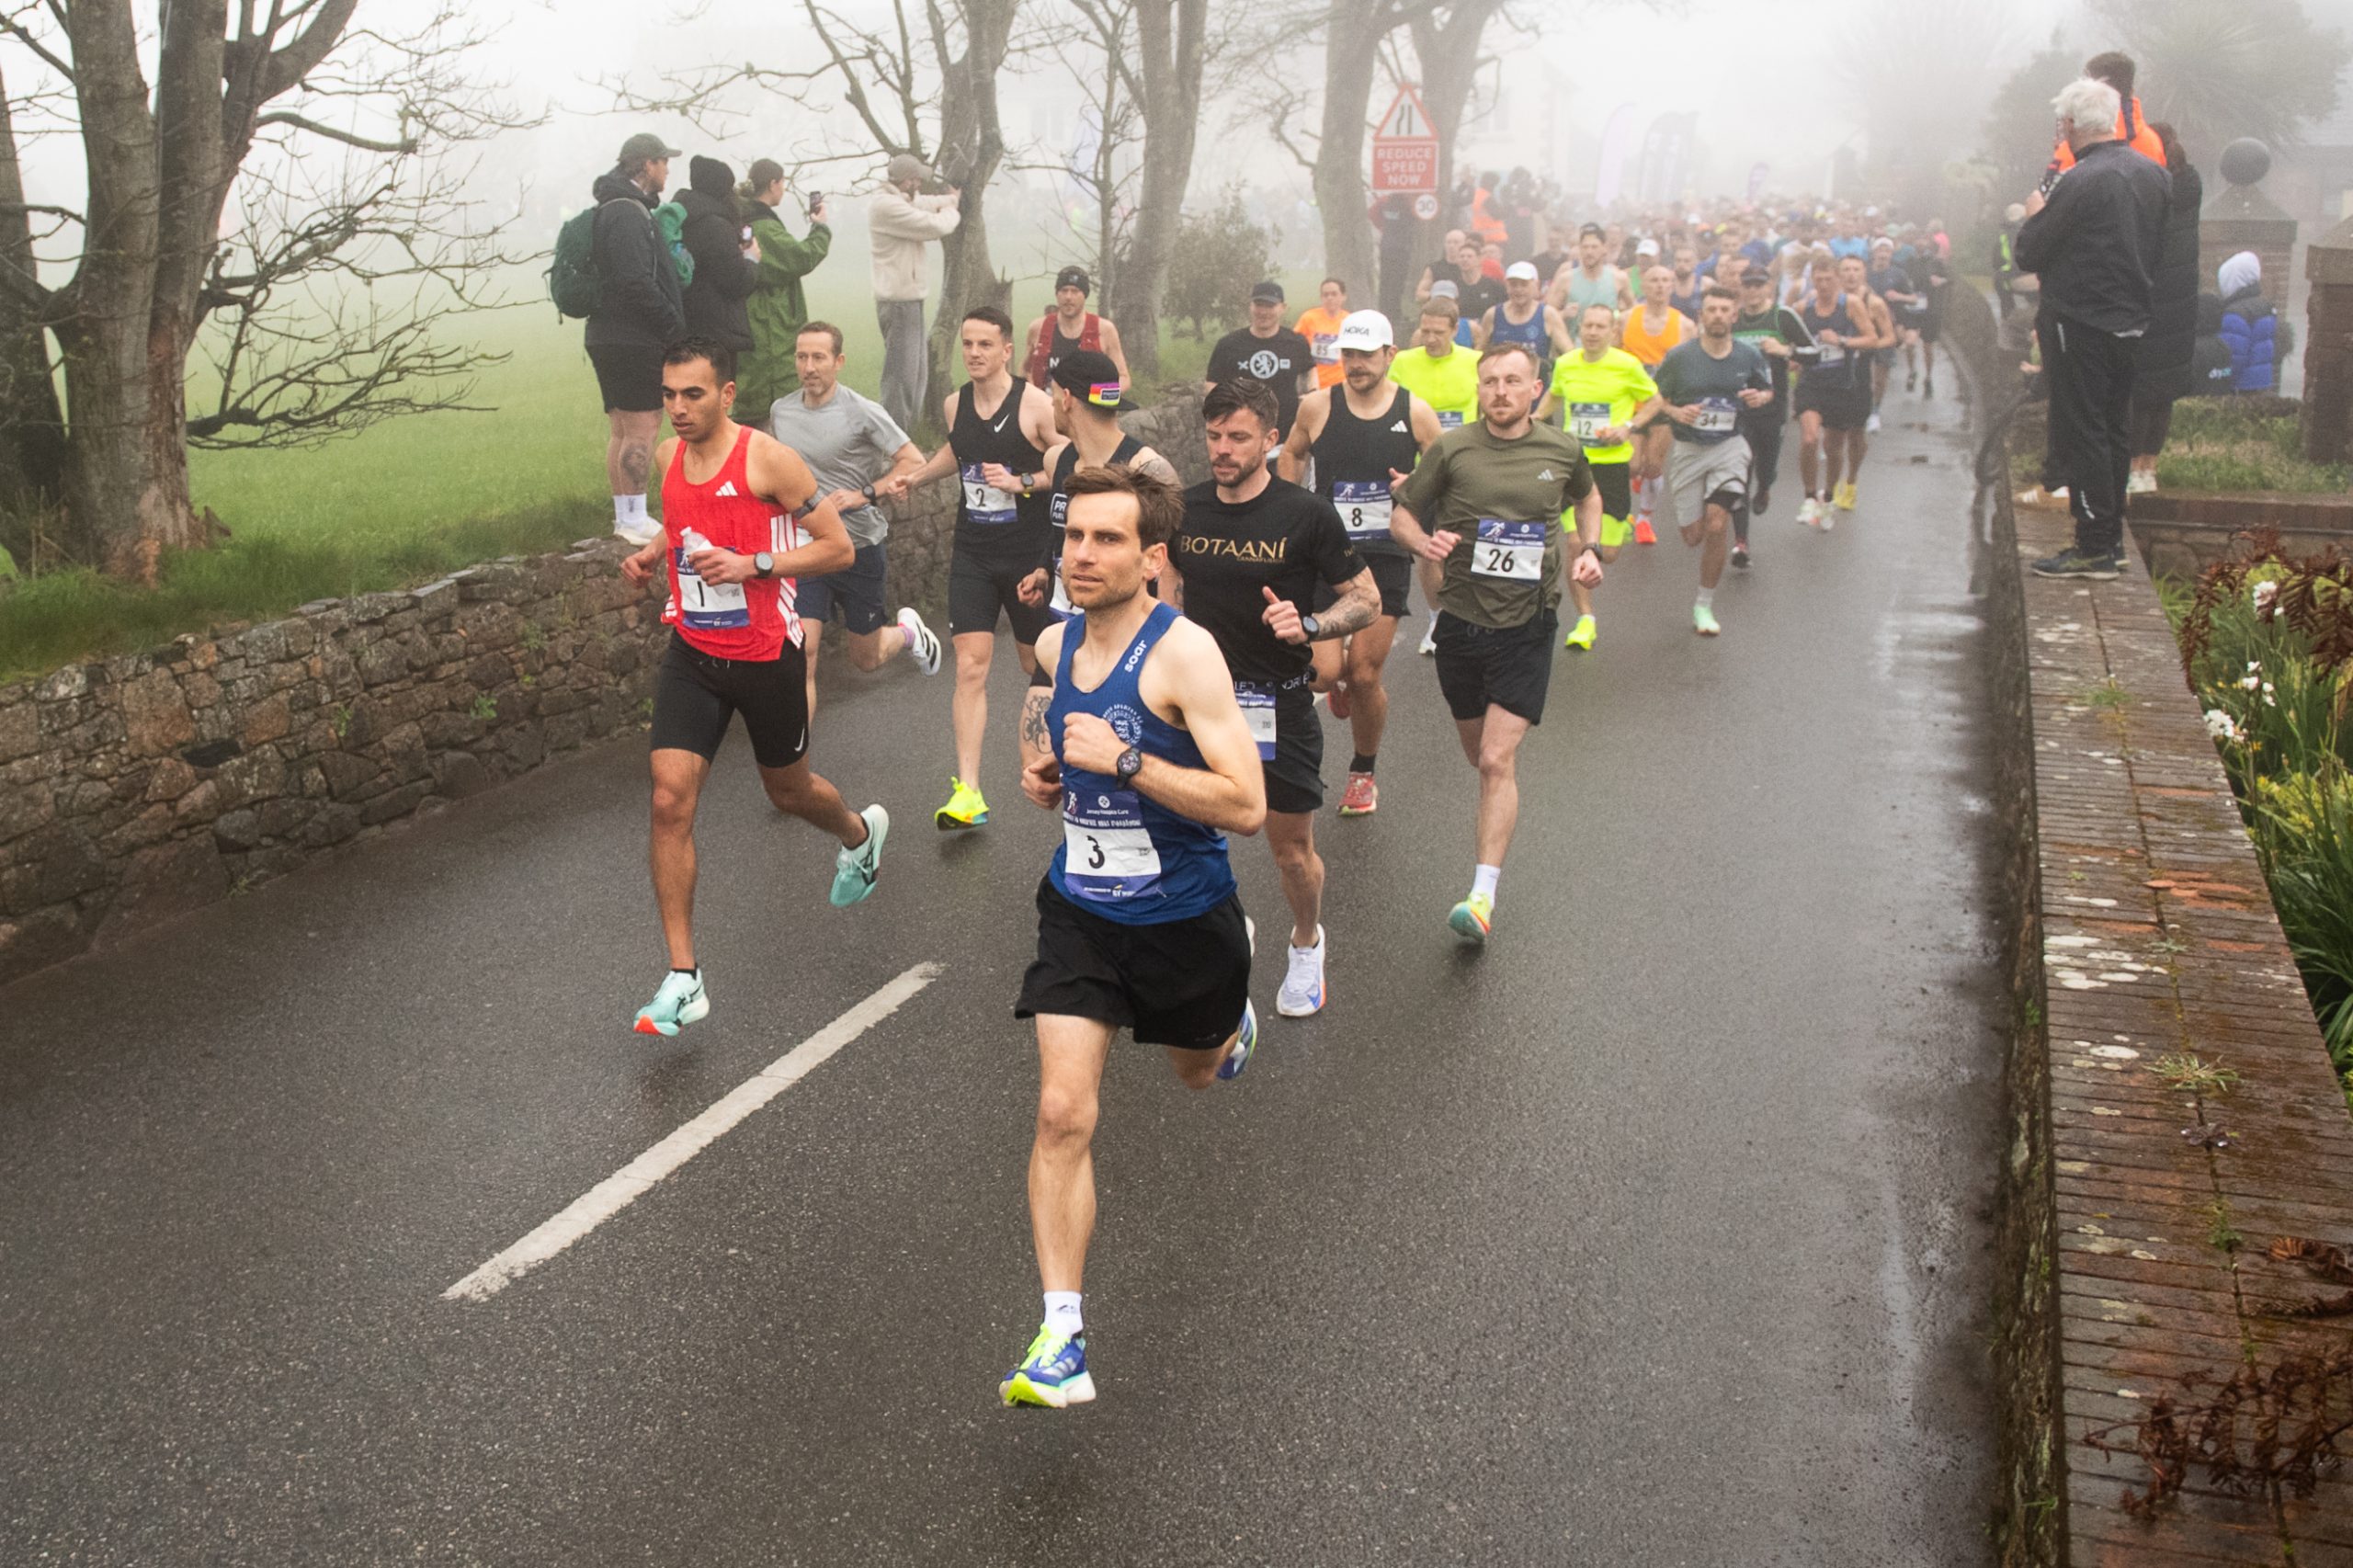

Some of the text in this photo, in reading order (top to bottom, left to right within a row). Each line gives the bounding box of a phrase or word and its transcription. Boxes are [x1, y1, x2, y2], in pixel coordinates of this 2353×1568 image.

[1377, 147, 1431, 159] REDUCE
[1381, 160, 1427, 173] SPEED
[1387, 175, 1421, 186] NOW
[1577, 419, 1592, 436] 12
[1700, 413, 1718, 426] 34
[976, 488, 986, 506] 2
[1352, 507, 1362, 527] 8
[1487, 549, 1514, 573] 26
[697, 581, 705, 607] 1
[1124, 640, 1147, 673] soar
[1086, 835, 1105, 869] 3
